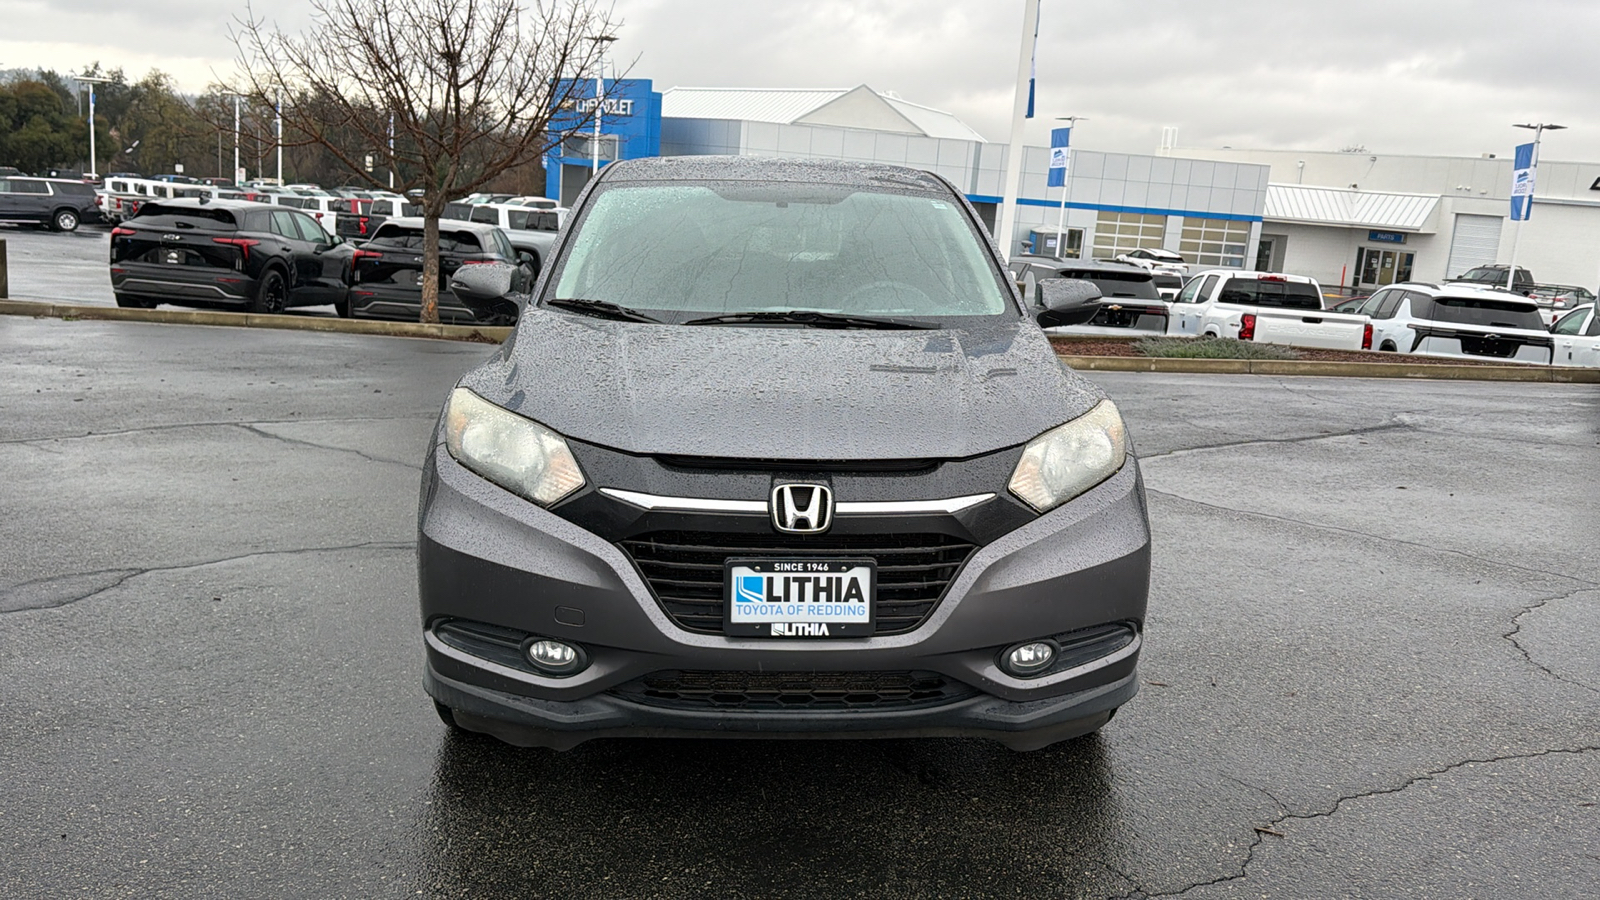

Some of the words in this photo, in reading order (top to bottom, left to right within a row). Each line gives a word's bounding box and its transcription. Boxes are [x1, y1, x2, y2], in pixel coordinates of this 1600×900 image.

[576, 98, 634, 115] CHEROLET
[1267, 324, 1354, 338] CHEVROLET
[774, 563, 804, 571] SINCE
[807, 563, 829, 571] 1946
[766, 576, 865, 603] LITHIA
[736, 604, 784, 616] TOYOTA
[787, 604, 804, 616] OF
[807, 604, 866, 616] REDDING
[784, 623, 830, 636] LITHIA
